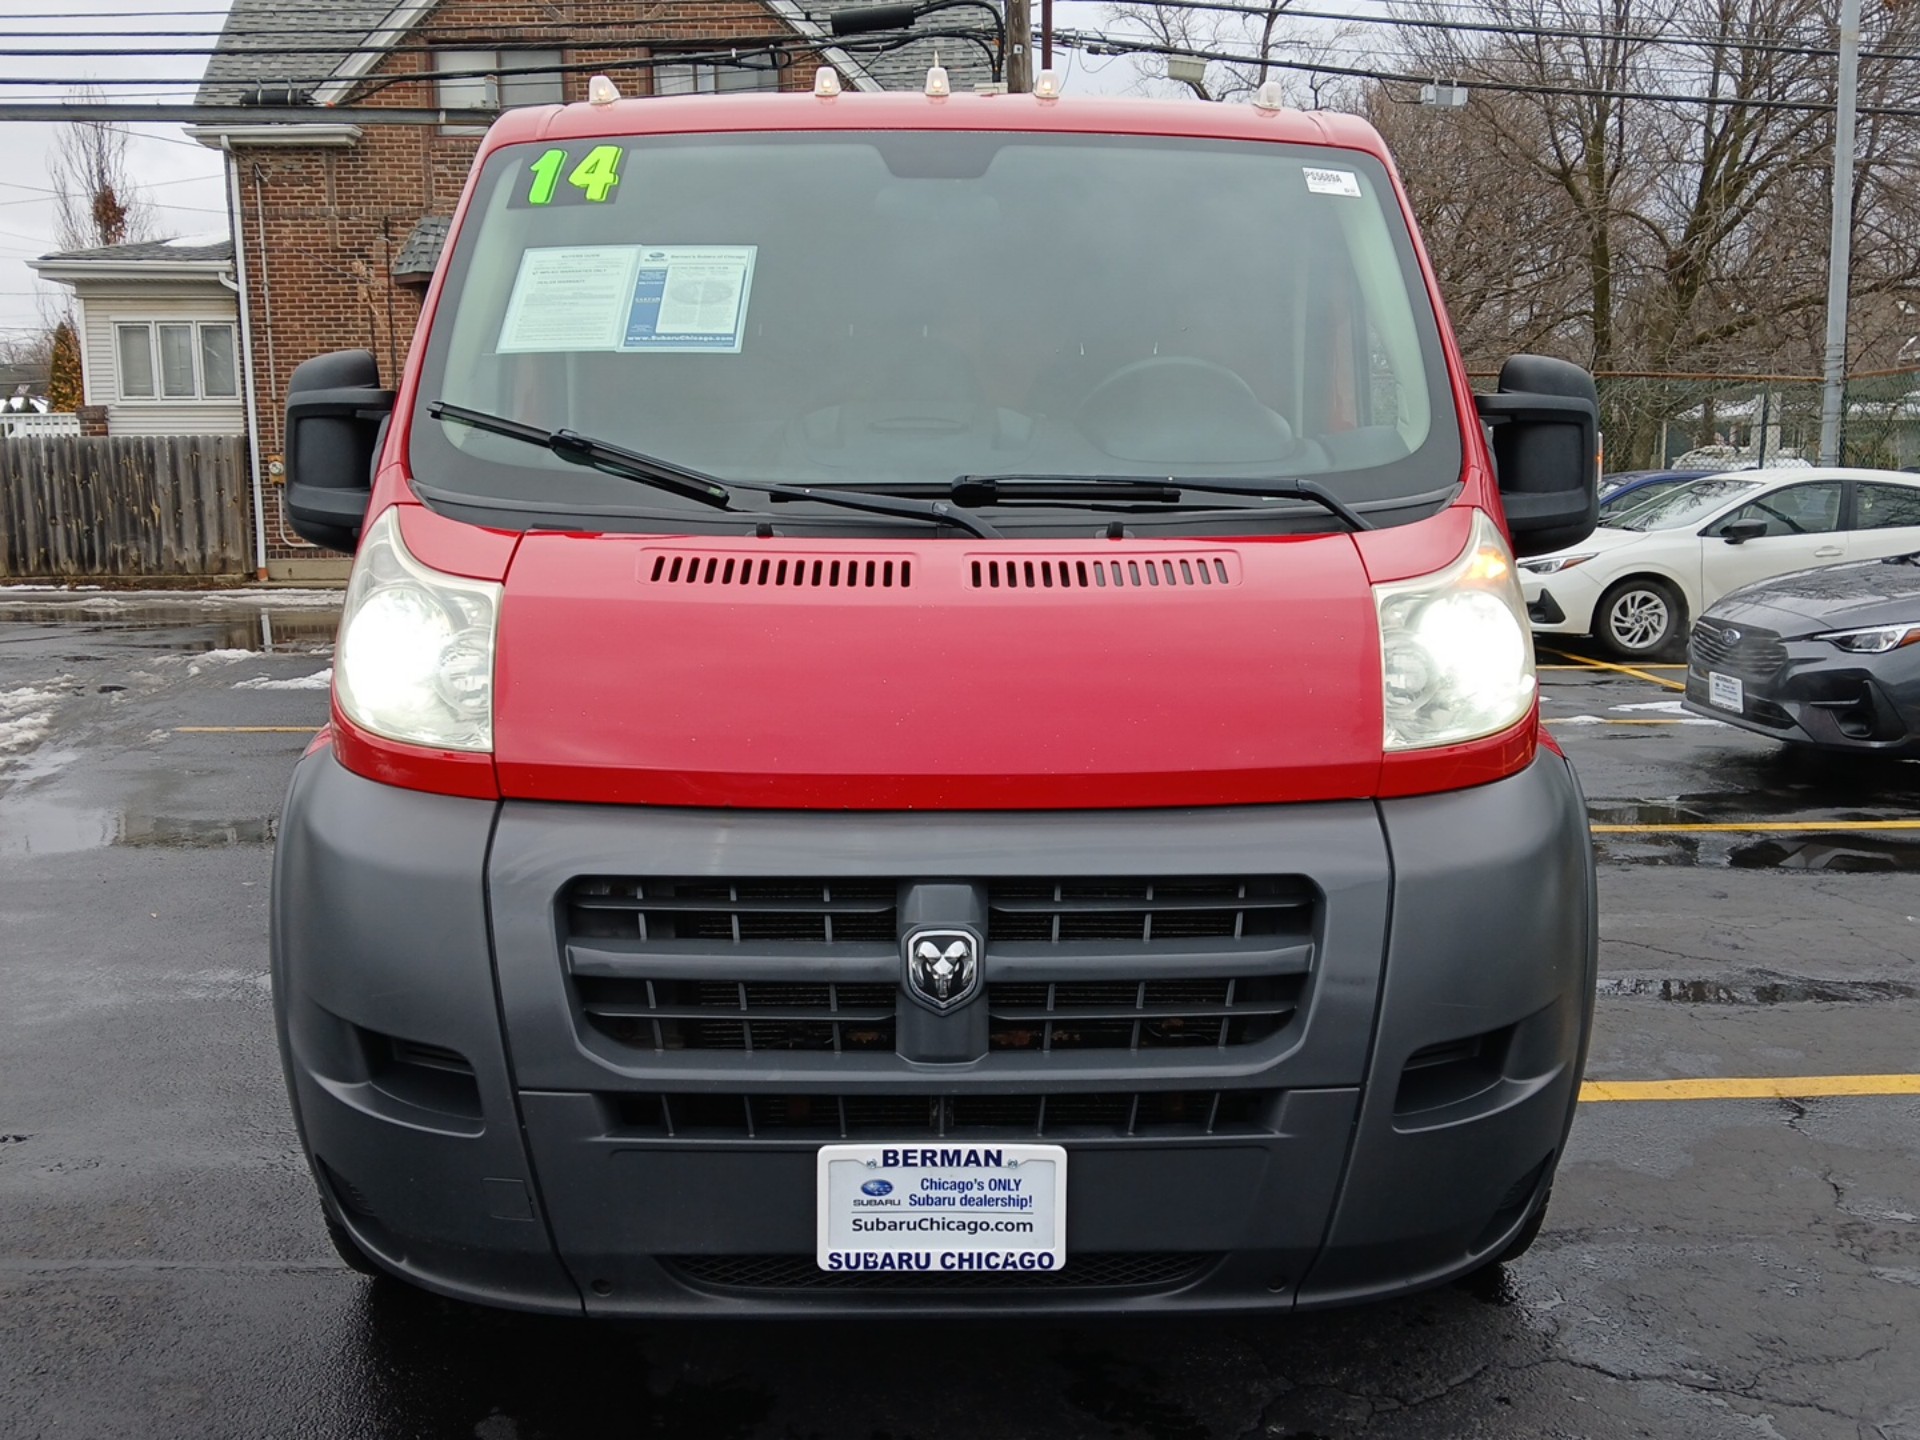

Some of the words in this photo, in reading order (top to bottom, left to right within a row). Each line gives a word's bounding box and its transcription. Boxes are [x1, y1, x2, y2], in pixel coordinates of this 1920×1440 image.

[528, 145, 623, 204] 14
[882, 1149, 1003, 1168] BERMAN
[920, 1178, 985, 1194] Chicago's
[988, 1178, 1022, 1191] ONLY
[908, 1194, 956, 1207] Subaru
[960, 1194, 1033, 1210] dealership!
[851, 1217, 1034, 1235] SubaruChicago.com
[828, 1252, 931, 1270] SUBARU
[940, 1252, 1055, 1270] CHICAGO
